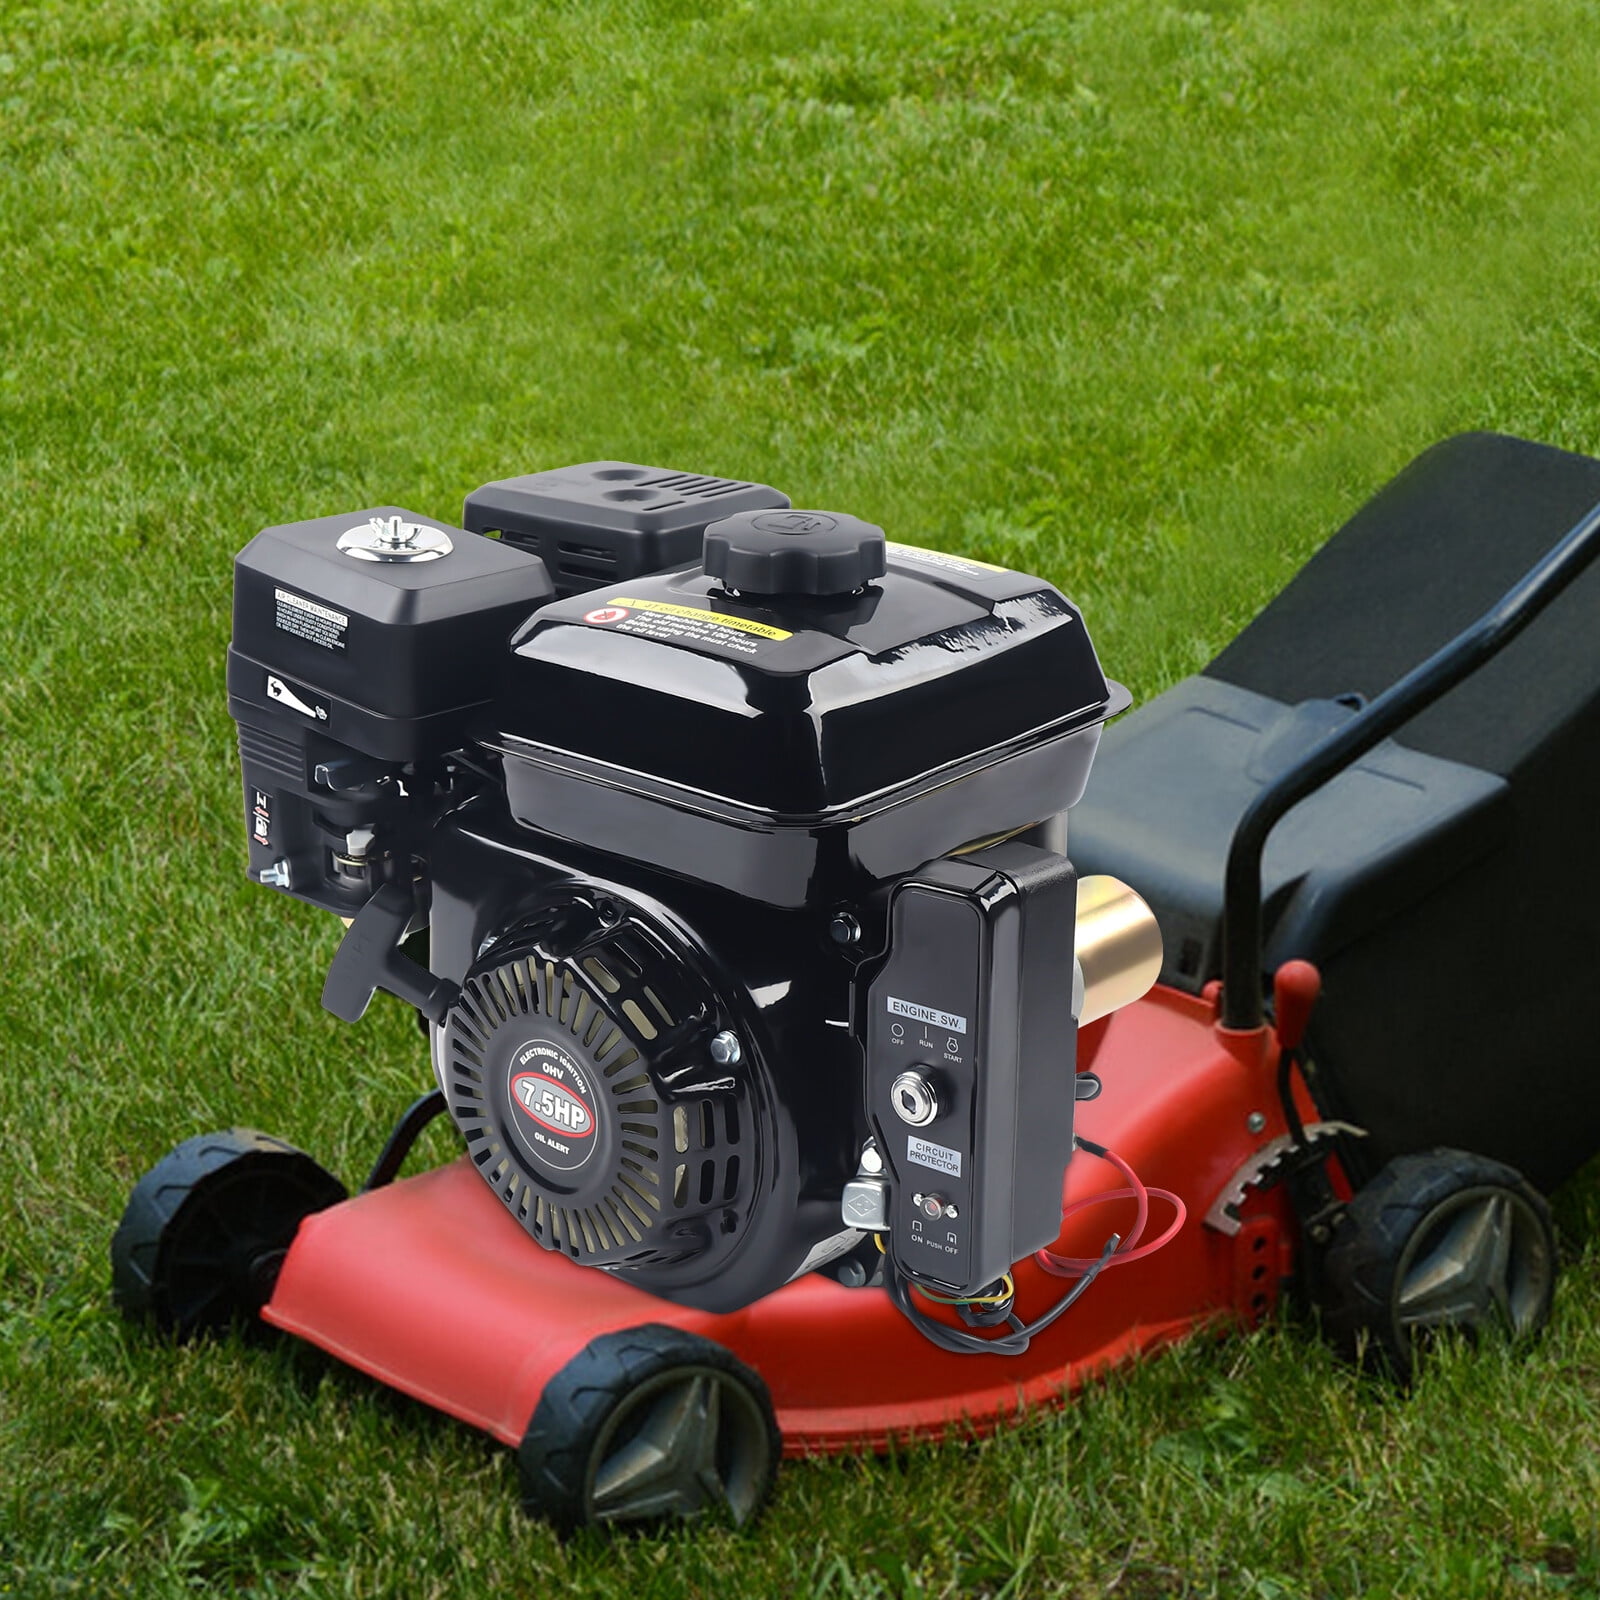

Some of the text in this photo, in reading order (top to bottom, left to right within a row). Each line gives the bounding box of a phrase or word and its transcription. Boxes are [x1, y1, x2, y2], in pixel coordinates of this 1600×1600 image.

[277, 591, 346, 626] AIR CLEANER MAINTENANCE
[663, 614, 703, 626] Machine
[717, 626, 746, 637] hours
[676, 607, 719, 621] change
[721, 617, 777, 636] timetable
[624, 619, 758, 654] Before using the must check
[645, 630, 671, 638] level
[668, 622, 709, 634] machine
[728, 635, 758, 647] hours
[891, 1037, 904, 1045] OFF
[919, 1039, 934, 1049] RUN
[943, 1052, 963, 1064] START
[519, 1047, 587, 1094] ELECTRONIC IGNITION
[542, 1062, 564, 1080] OHV
[521, 1080, 586, 1130] 7.5HP
[534, 1131, 570, 1155] OIL ALERT
[915, 1142, 954, 1161] CIRCUIT
[910, 1150, 959, 1172] PROTECTOR
[911, 1234, 958, 1255] ON PUSH OFF
